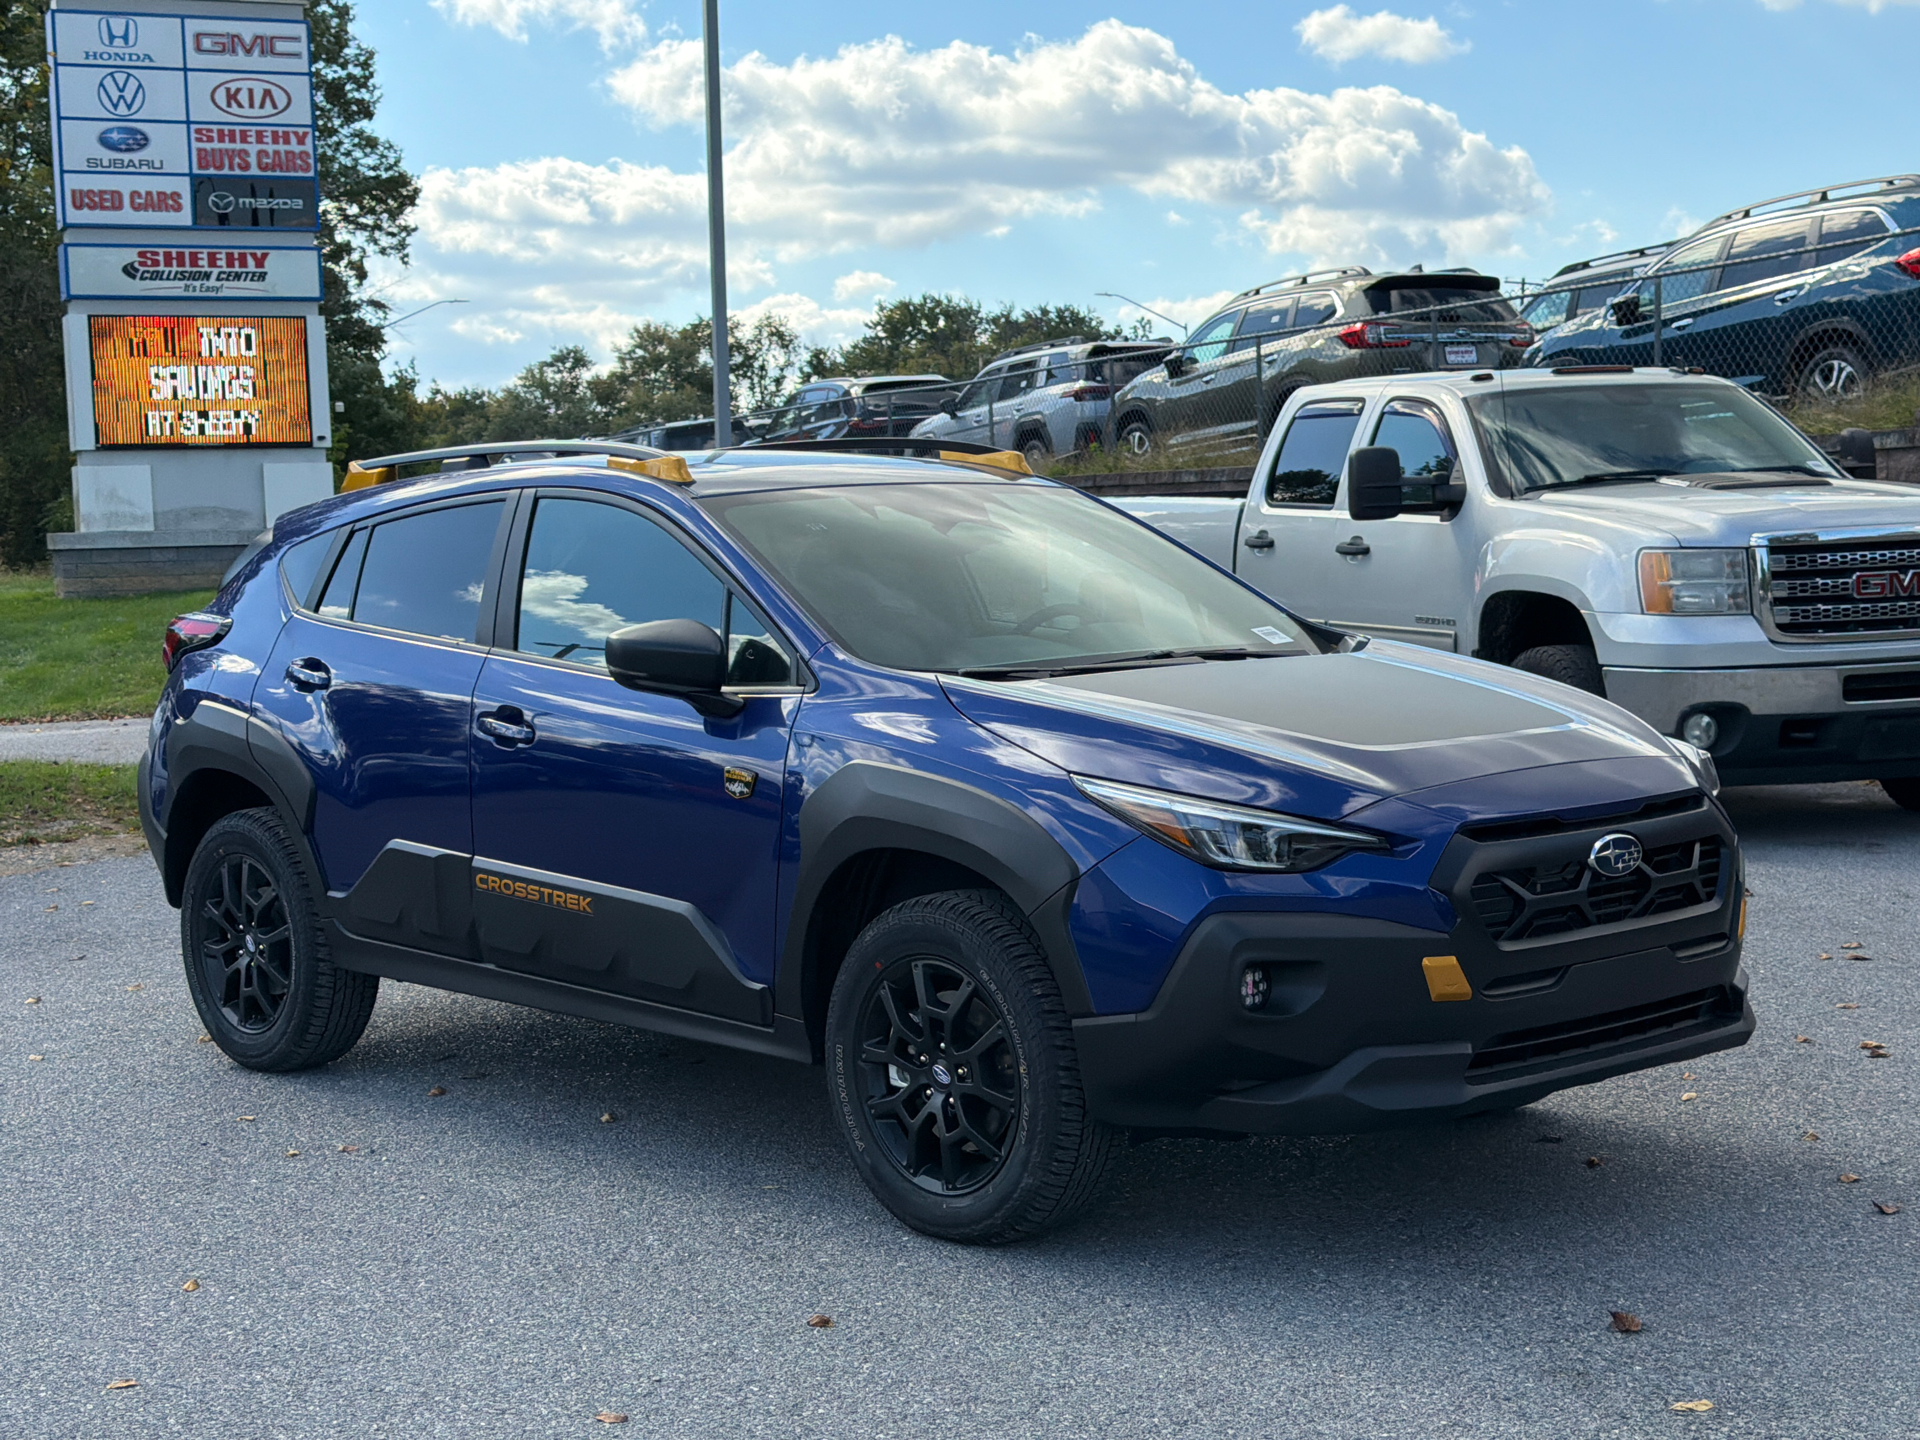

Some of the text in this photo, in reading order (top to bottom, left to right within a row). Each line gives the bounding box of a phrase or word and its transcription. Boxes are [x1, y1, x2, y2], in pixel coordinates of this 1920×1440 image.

[193, 32, 302, 59] GMC
[83, 50, 155, 63] HONDA
[224, 87, 279, 110] KIA
[194, 127, 309, 146] SHEEHY
[86, 157, 164, 170] SUBARU
[195, 147, 312, 174] BUYS CARS
[70, 188, 183, 213] USED CARS
[238, 197, 304, 210] mazda
[137, 250, 270, 269] SHEEHY
[139, 269, 268, 282] COLLISION CENTER
[183, 283, 225, 294] It's Easy!
[150, 365, 256, 400] SAVINGS
[475, 873, 594, 914] CROSSTREK
[835, 1044, 866, 1152] YOKOHAMA
